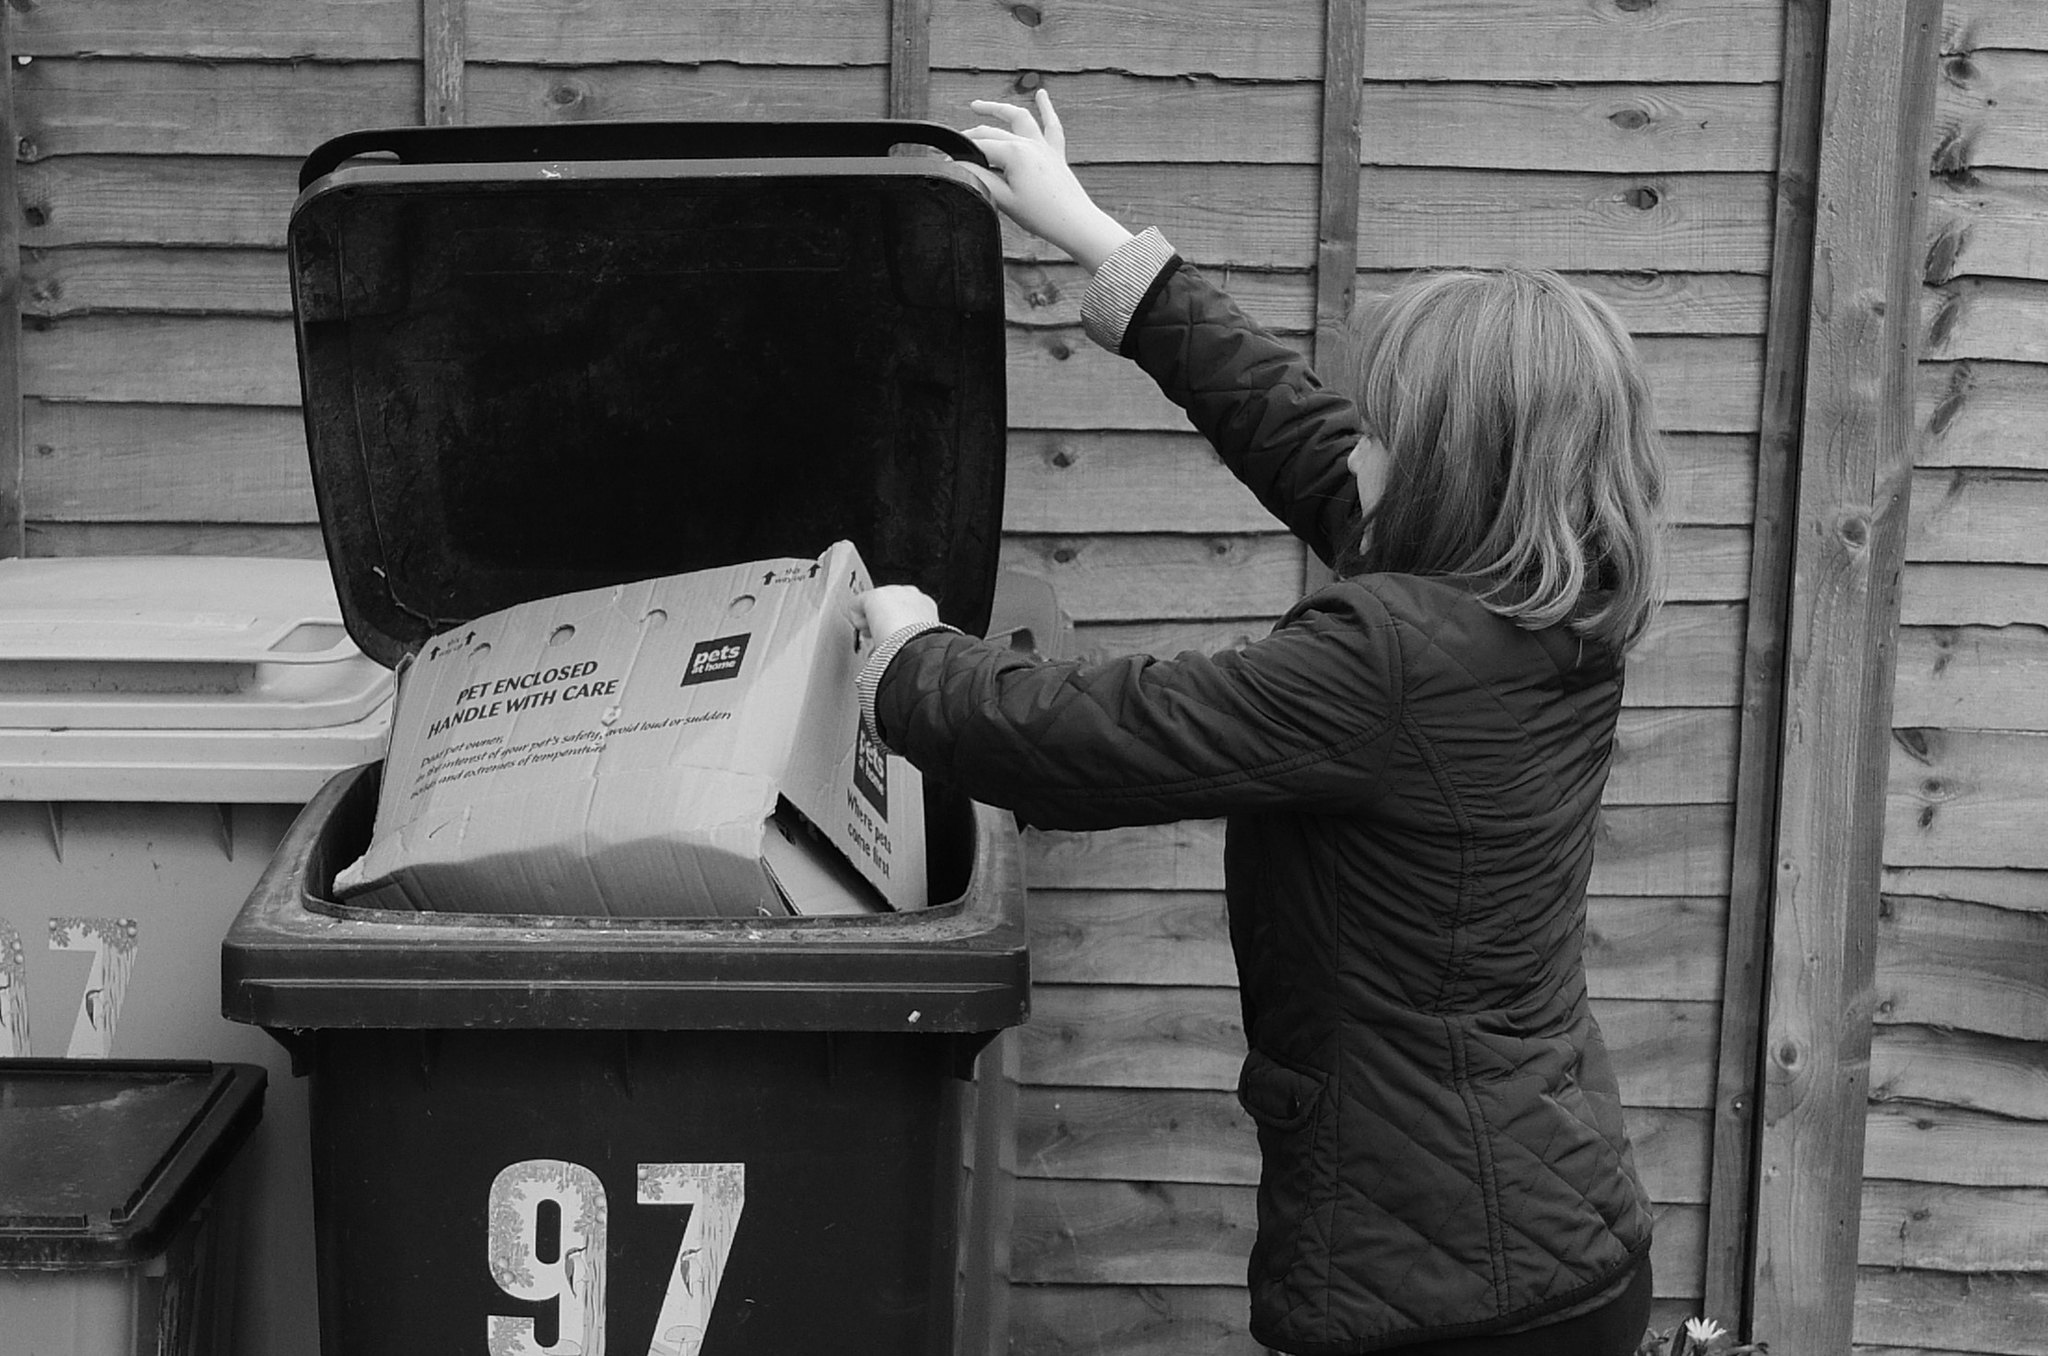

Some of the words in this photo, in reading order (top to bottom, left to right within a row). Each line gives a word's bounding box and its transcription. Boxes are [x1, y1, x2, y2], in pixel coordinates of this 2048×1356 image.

[456, 682, 492, 705] PET
[493, 660, 598, 696] ENCLOSED
[691, 665, 703, 675] at
[704, 660, 736, 673] home
[692, 645, 741, 667] pets
[427, 701, 502, 740] HANDLE
[506, 689, 558, 714] WITH
[562, 679, 620, 702] CARE
[442, 752, 488, 769] interest
[488, 746, 503, 760] of
[500, 742, 530, 761] your
[605, 721, 640, 737] avoid
[640, 718, 670, 732] loud
[669, 718, 684, 728] or
[683, 710, 732, 726] sudden
[438, 769, 464, 784] and
[517, 753, 532, 768] of
[846, 786, 873, 833] Where
[874, 826, 892, 855] pets
[847, 822, 871, 857] come
[872, 846, 890, 879] first
[487, 1159, 746, 1356] 97
